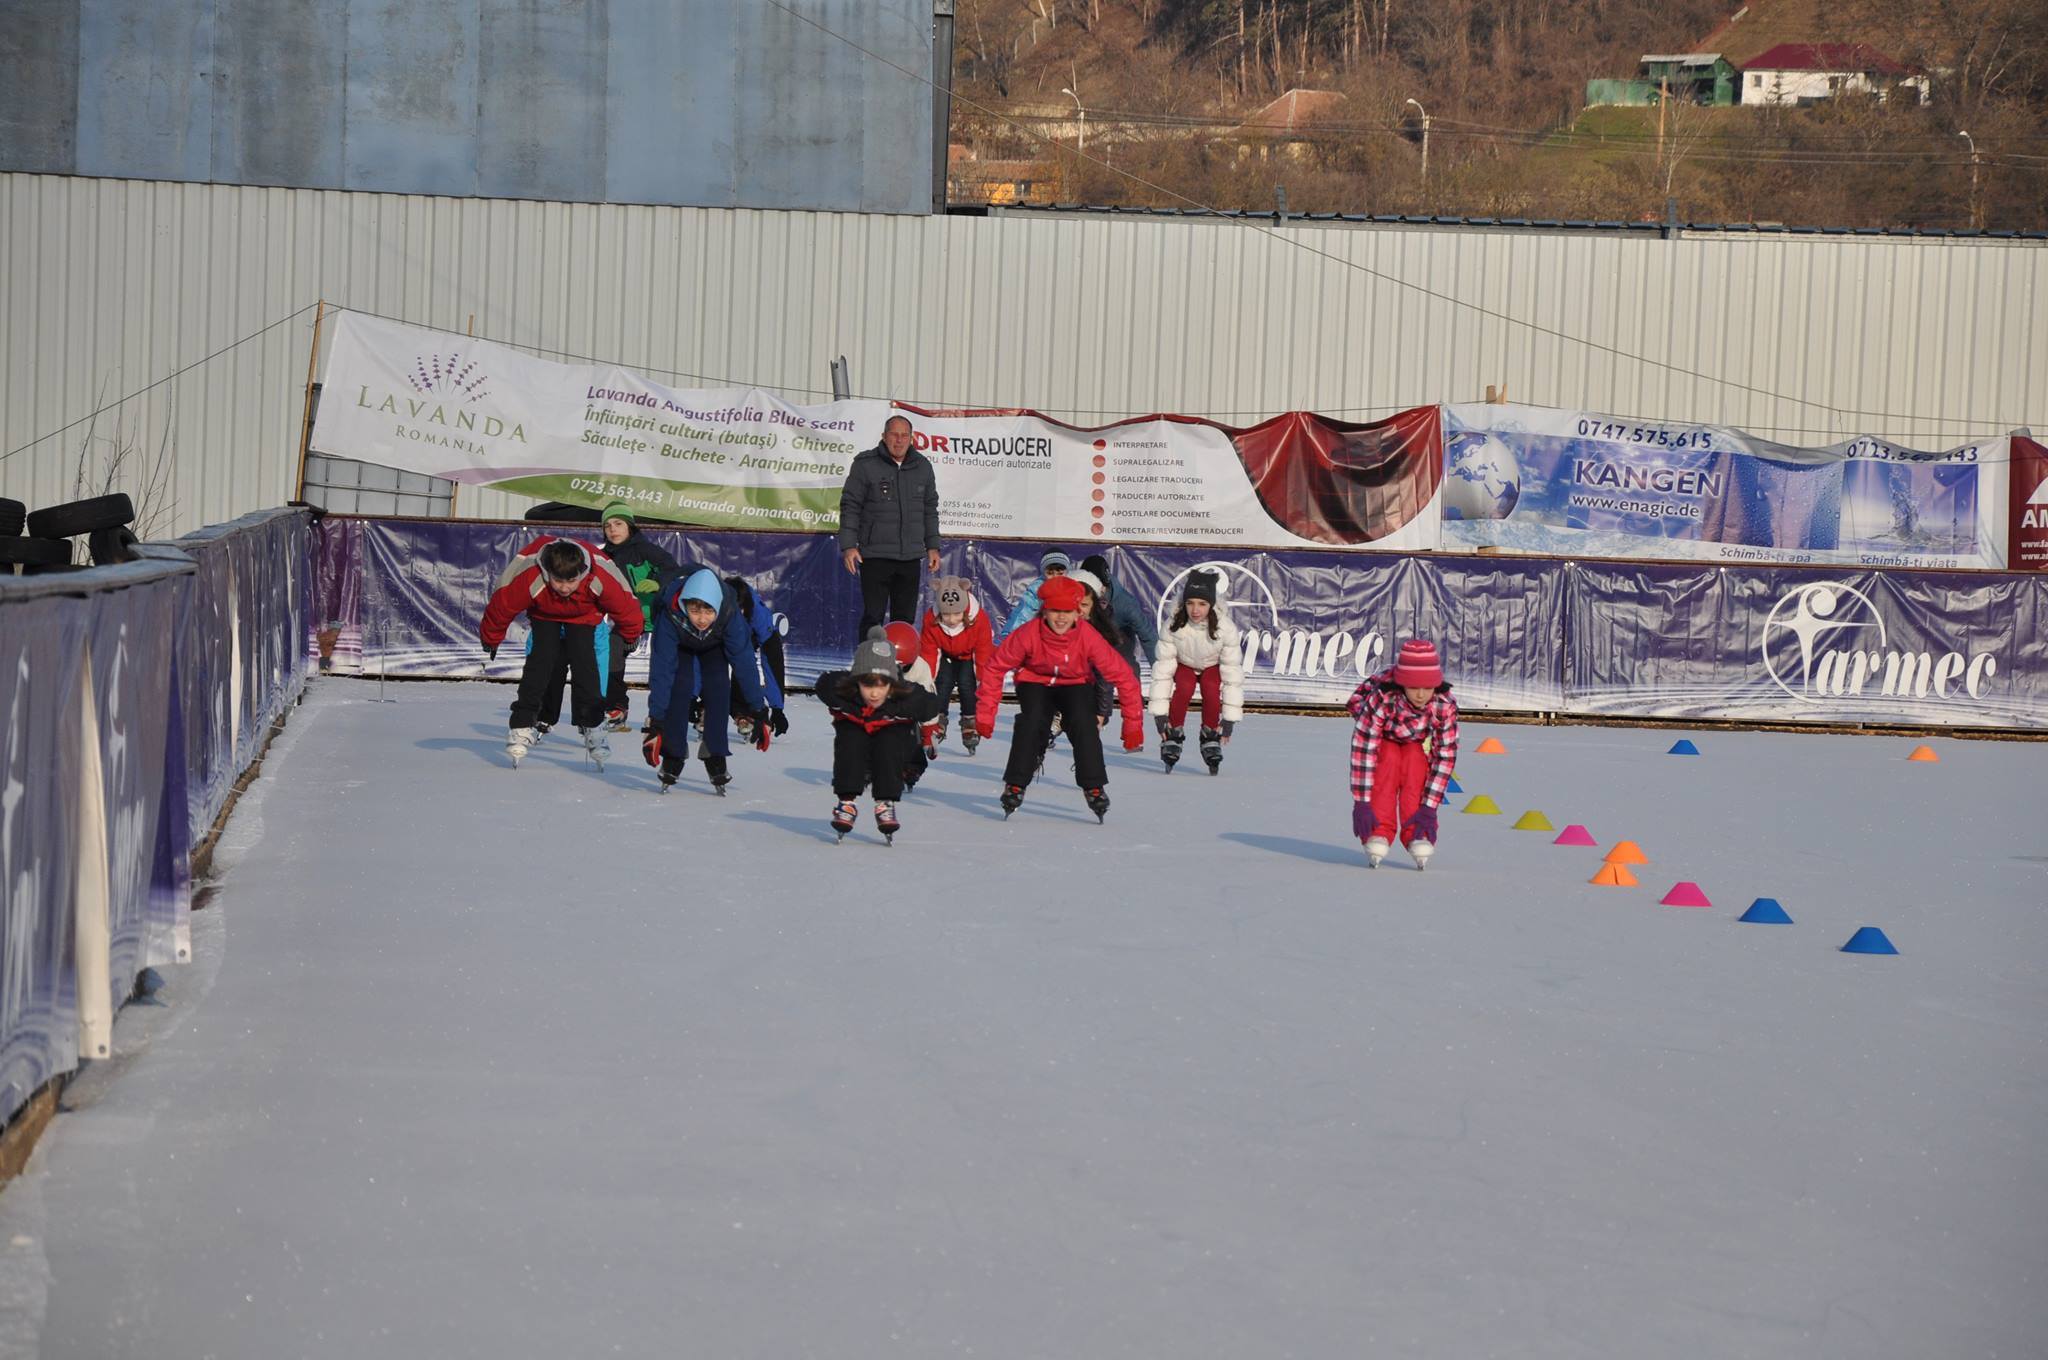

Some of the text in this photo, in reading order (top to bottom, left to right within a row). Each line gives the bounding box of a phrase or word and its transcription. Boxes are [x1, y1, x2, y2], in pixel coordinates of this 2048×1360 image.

[357, 385, 528, 443] LAVANDA
[587, 385, 855, 432] Lavanda Angustifolia Blue scent
[396, 424, 486, 456] ROMANIA
[659, 421, 713, 442] culturi
[792, 436, 855, 454] Ghivece
[1577, 419, 1712, 449] 0747.575.615
[660, 443, 726, 465] Buchete
[739, 453, 845, 477] Aranjamente
[942, 455, 955, 465] de
[958, 456, 1004, 468] traduceri
[1006, 460, 1051, 470] autorizate
[1113, 458, 1184, 466] SUPRALEGALIZARE
[570, 477, 663, 504] 0723.563.443
[1575, 460, 1722, 497] KANGEN
[1572, 495, 1700, 518] www.enagic.de
[1788, 554, 1811, 564] apa
